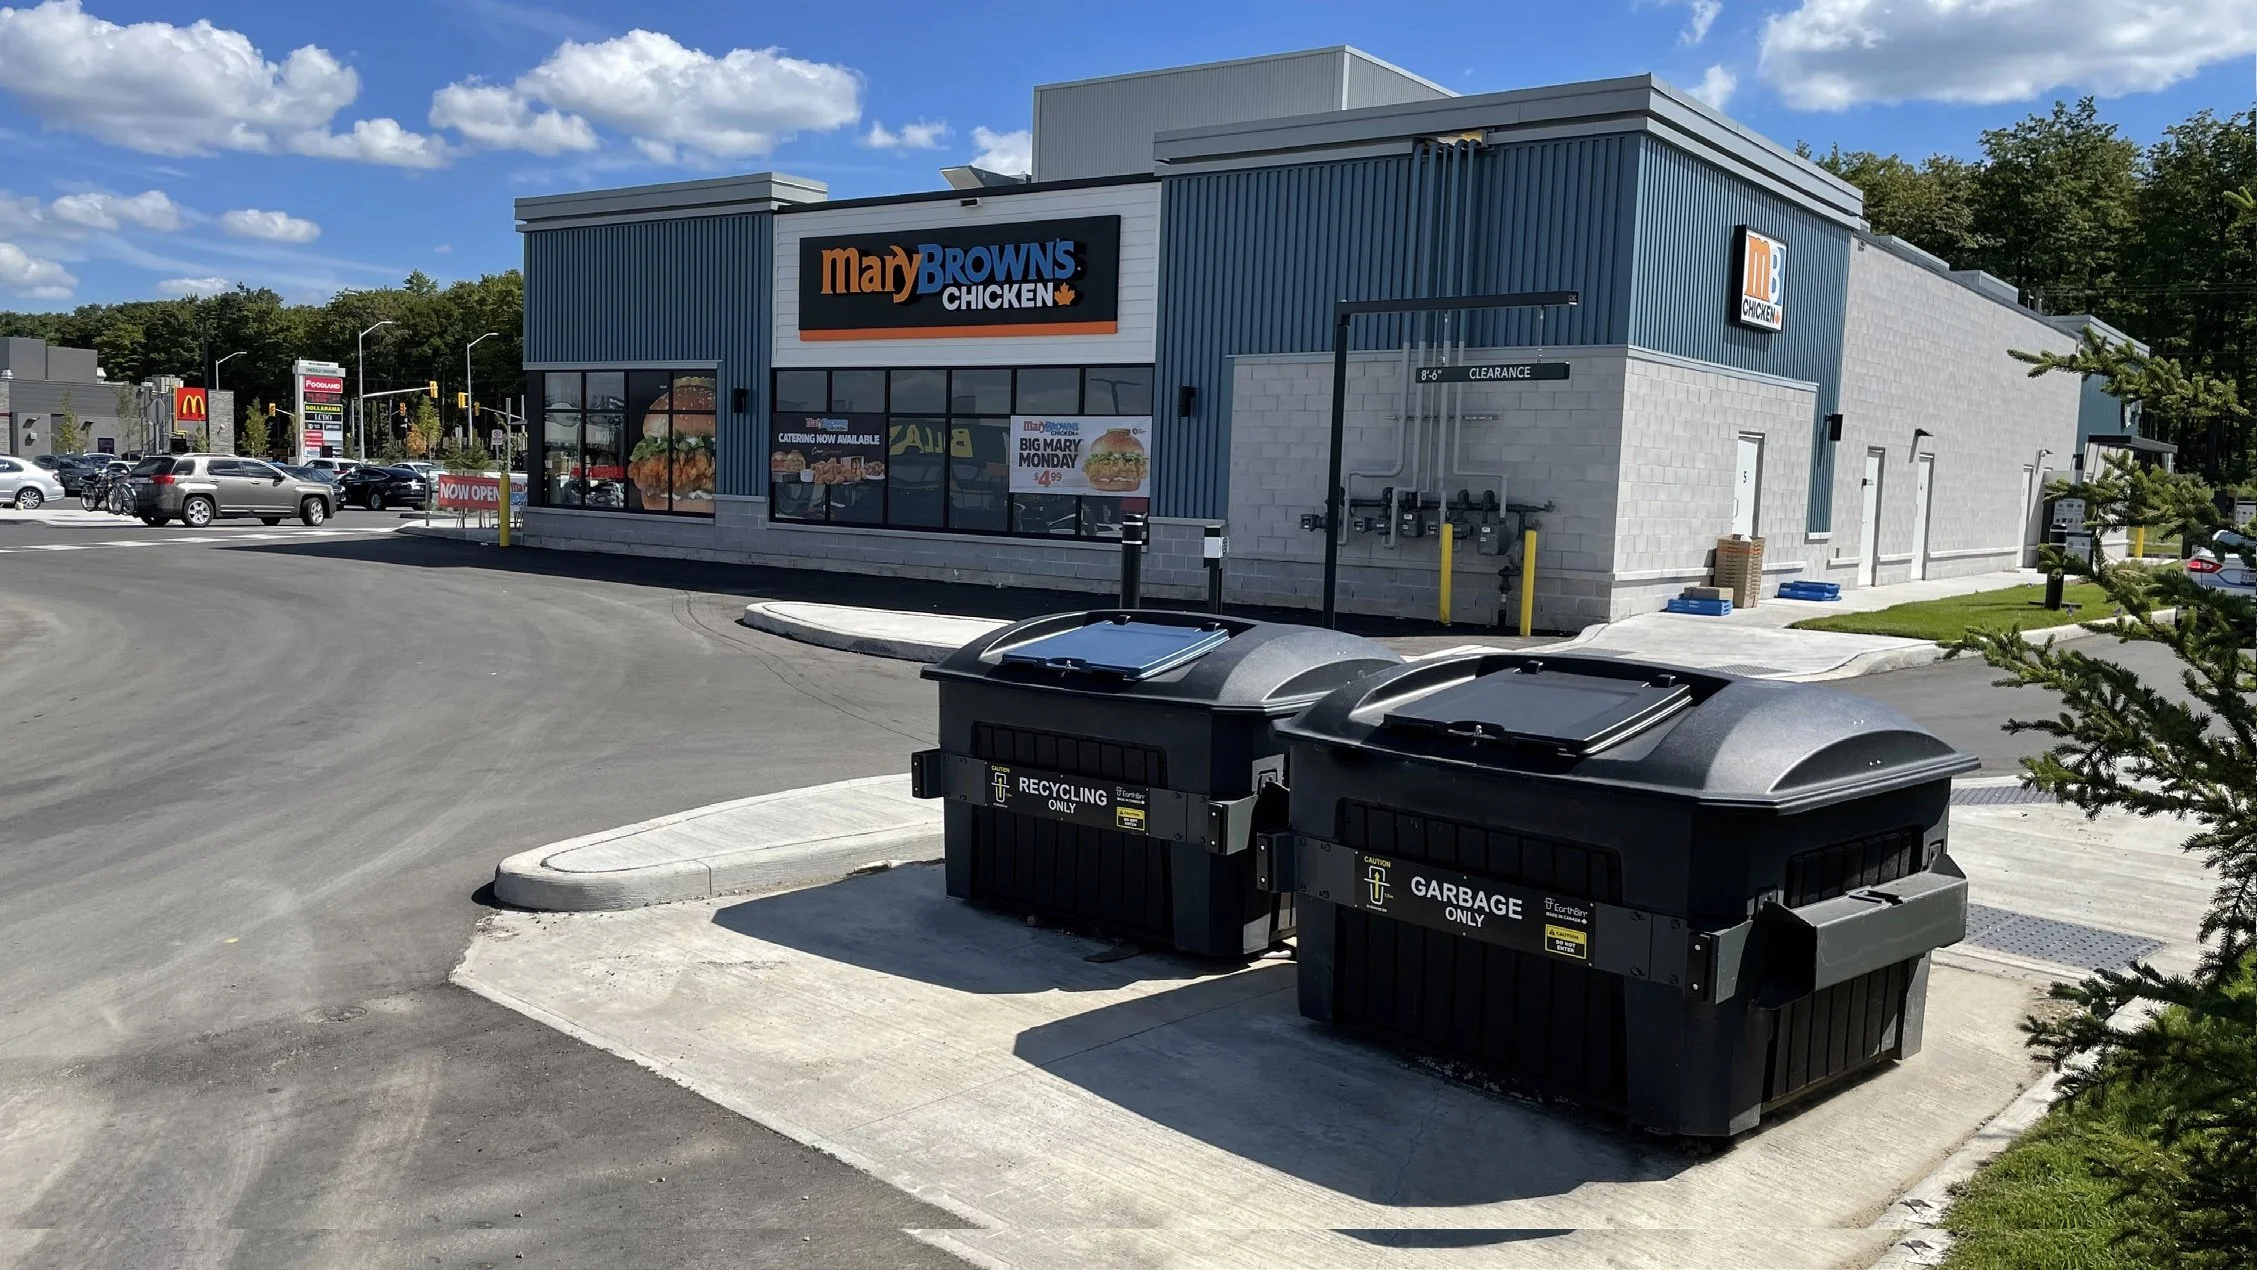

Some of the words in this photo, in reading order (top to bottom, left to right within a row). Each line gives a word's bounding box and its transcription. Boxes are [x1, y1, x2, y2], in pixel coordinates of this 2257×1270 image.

[942, 282, 1053, 310] CHICKEN
[1742, 298, 1776, 324] CHICKEN
[1469, 366, 1531, 379] CLEARANCE
[778, 432, 815, 443] CATERING
[816, 434, 836, 444] NOW
[837, 434, 880, 445] AVAILABLE
[1020, 437, 1041, 451] BIG
[1043, 438, 1082, 452] MARY
[1019, 452, 1078, 469] MONDAY
[440, 482, 469, 500] NOW
[471, 485, 500, 502] OPEN
[1019, 776, 1108, 807] RECYCLING
[1048, 799, 1076, 814] ONLY
[1364, 855, 1391, 868] CAUTION
[1411, 875, 1523, 920] GARBAGE
[1445, 906, 1486, 928] ONLY
[1556, 931, 1579, 940] CAUTION
[1556, 944, 1575, 953] ENTER
